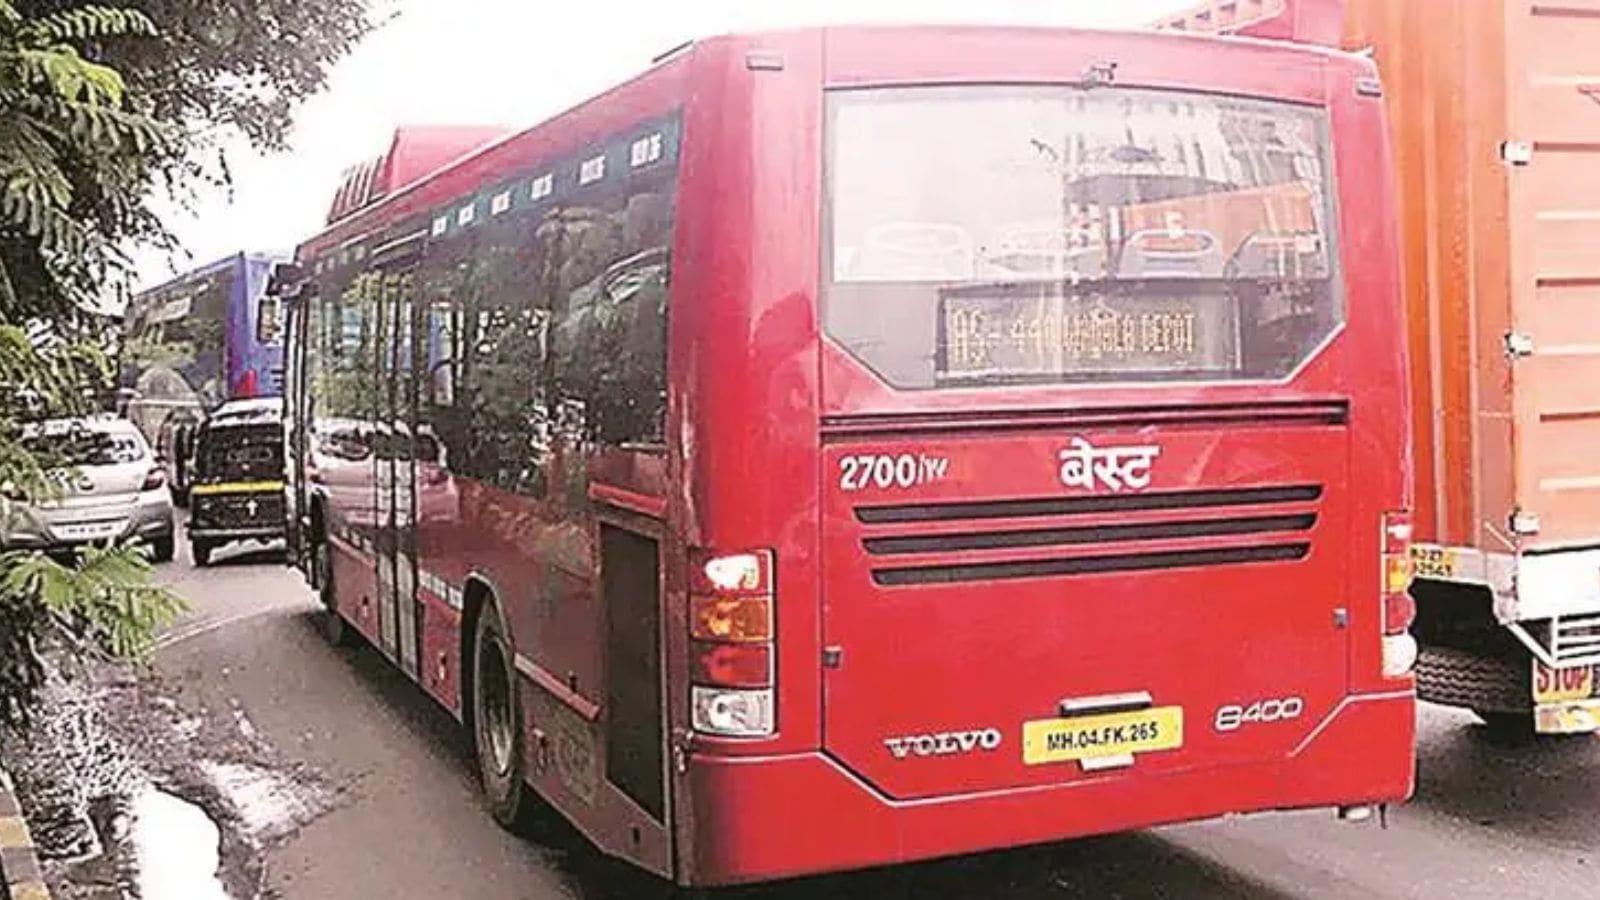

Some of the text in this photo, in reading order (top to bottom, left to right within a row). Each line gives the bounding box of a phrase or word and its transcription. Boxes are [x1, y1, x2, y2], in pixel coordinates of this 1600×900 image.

[1059, 437, 1160, 491] बेस्ट
[1215, 697, 1303, 731] 8400
[883, 727, 1002, 758] VOLVO
